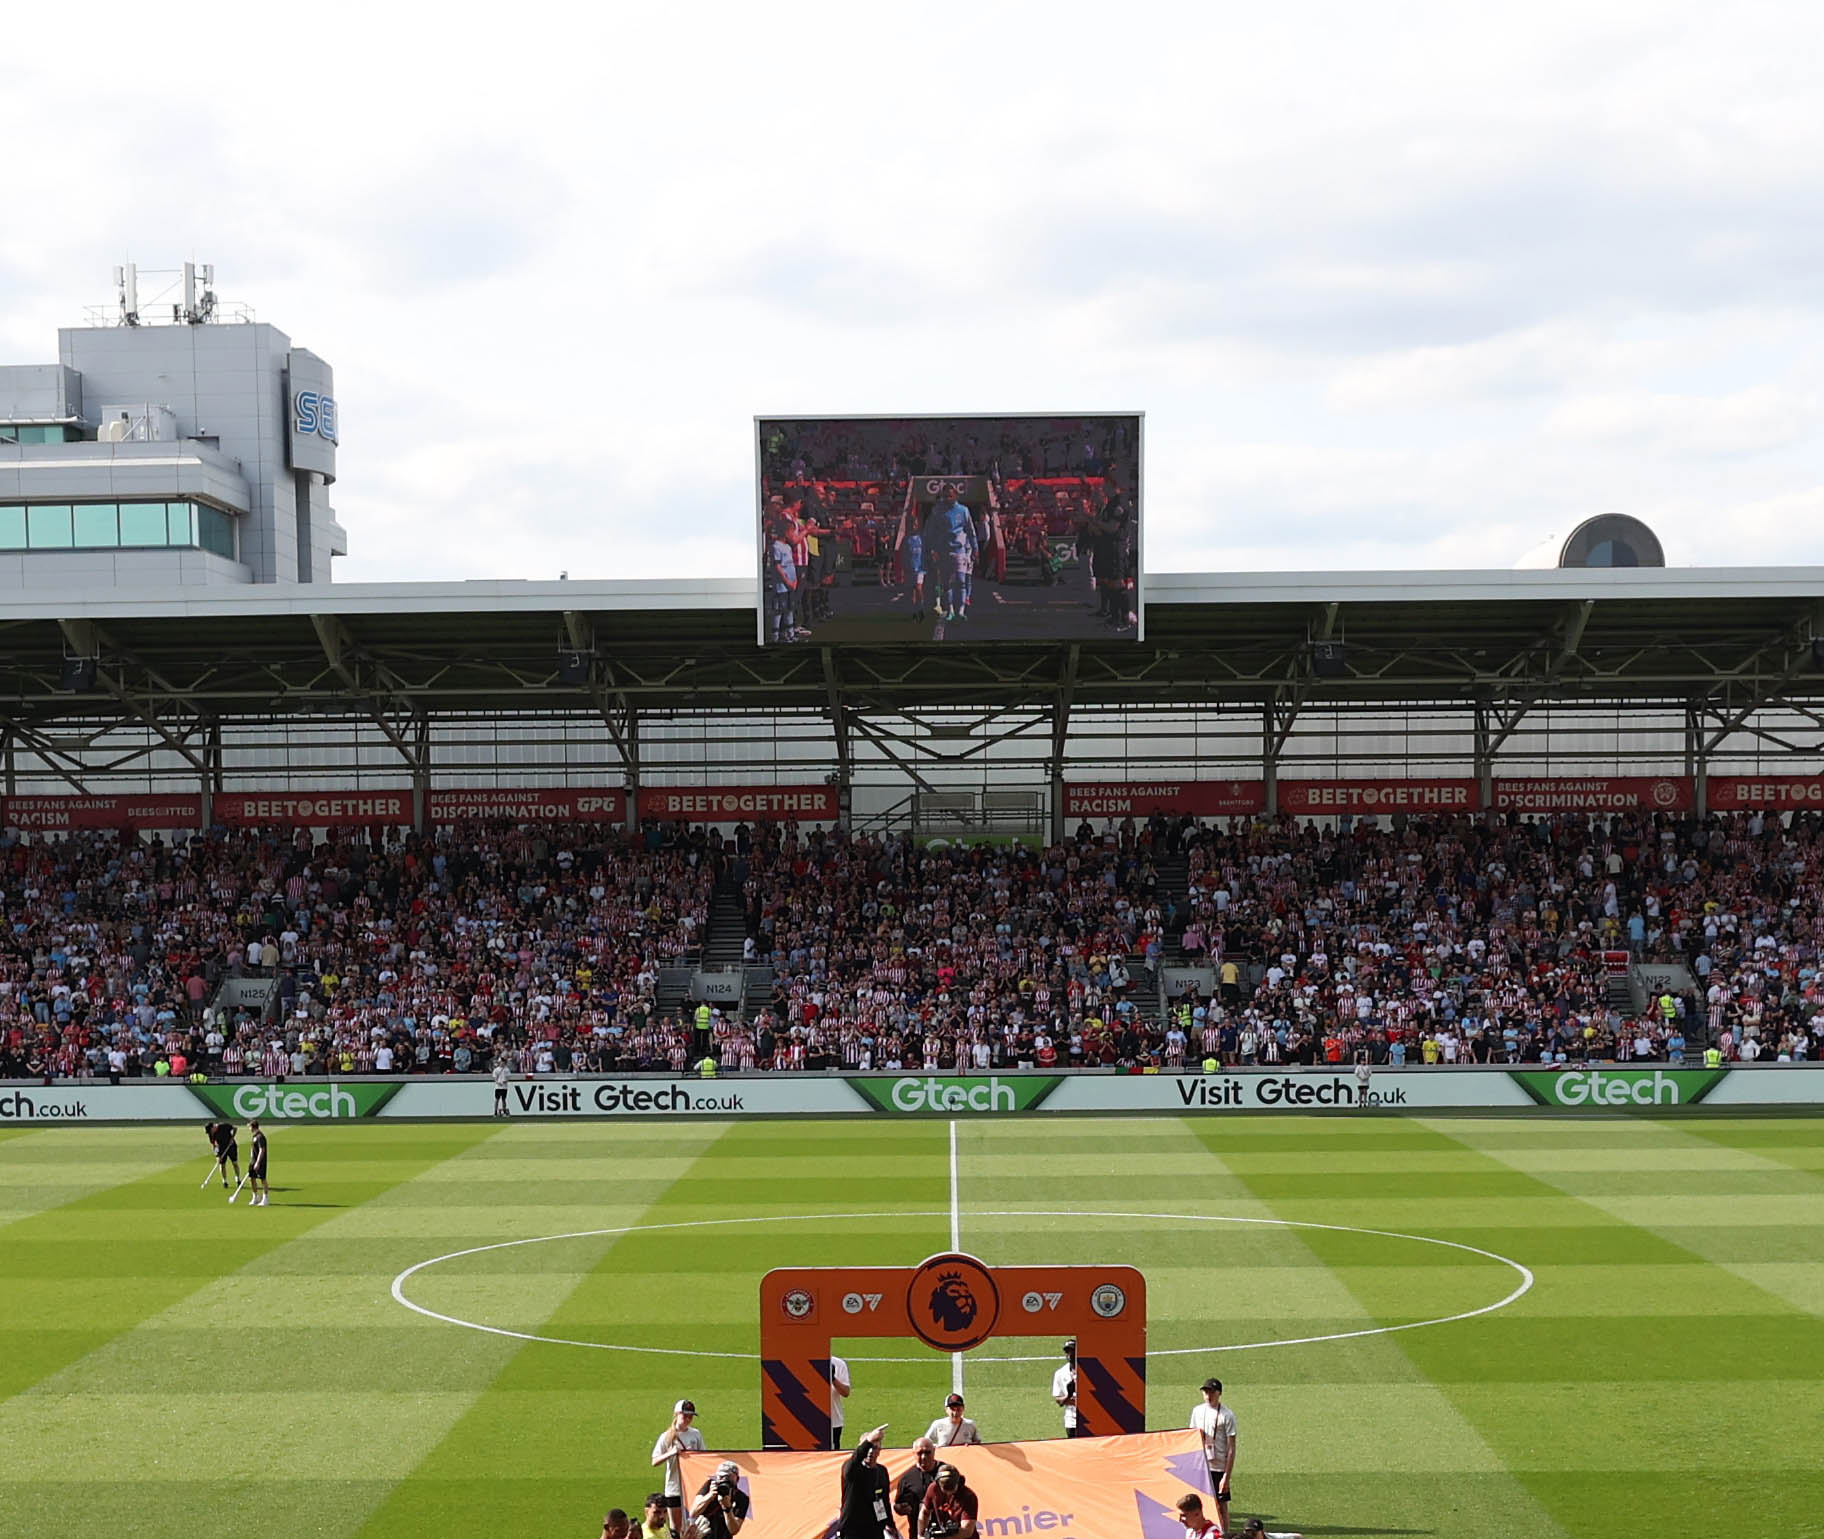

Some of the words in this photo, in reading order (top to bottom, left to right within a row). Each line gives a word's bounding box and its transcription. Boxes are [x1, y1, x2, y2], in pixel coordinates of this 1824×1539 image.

[1069, 787, 1096, 797] BEES
[1098, 787, 1128, 797] FANS
[1130, 786, 1180, 796] AGAINST
[1498, 782, 1524, 791] BEES
[1527, 782, 1555, 791] FANS
[1558, 781, 1608, 790] AGAINST
[431, 794, 457, 803] BEES
[460, 794, 489, 803] FANS
[491, 793, 541, 802] AGAINST
[8, 801, 35, 810] BEES
[37, 801, 66, 810] FANS
[68, 800, 117, 809] AGAINST
[1069, 799, 1131, 812] RACISM
[9, 812, 69, 825] RACISM
[892, 1077, 1015, 1111] Gtech
[1176, 1077, 1243, 1106] Visit
[1256, 1077, 1407, 1106] Gtech.o.uk
[1555, 1071, 1679, 1106] Gtech
[233, 1083, 356, 1118] Gtech
[513, 1084, 581, 1112] Visit
[593, 1083, 743, 1112] Gtech.co.uk
